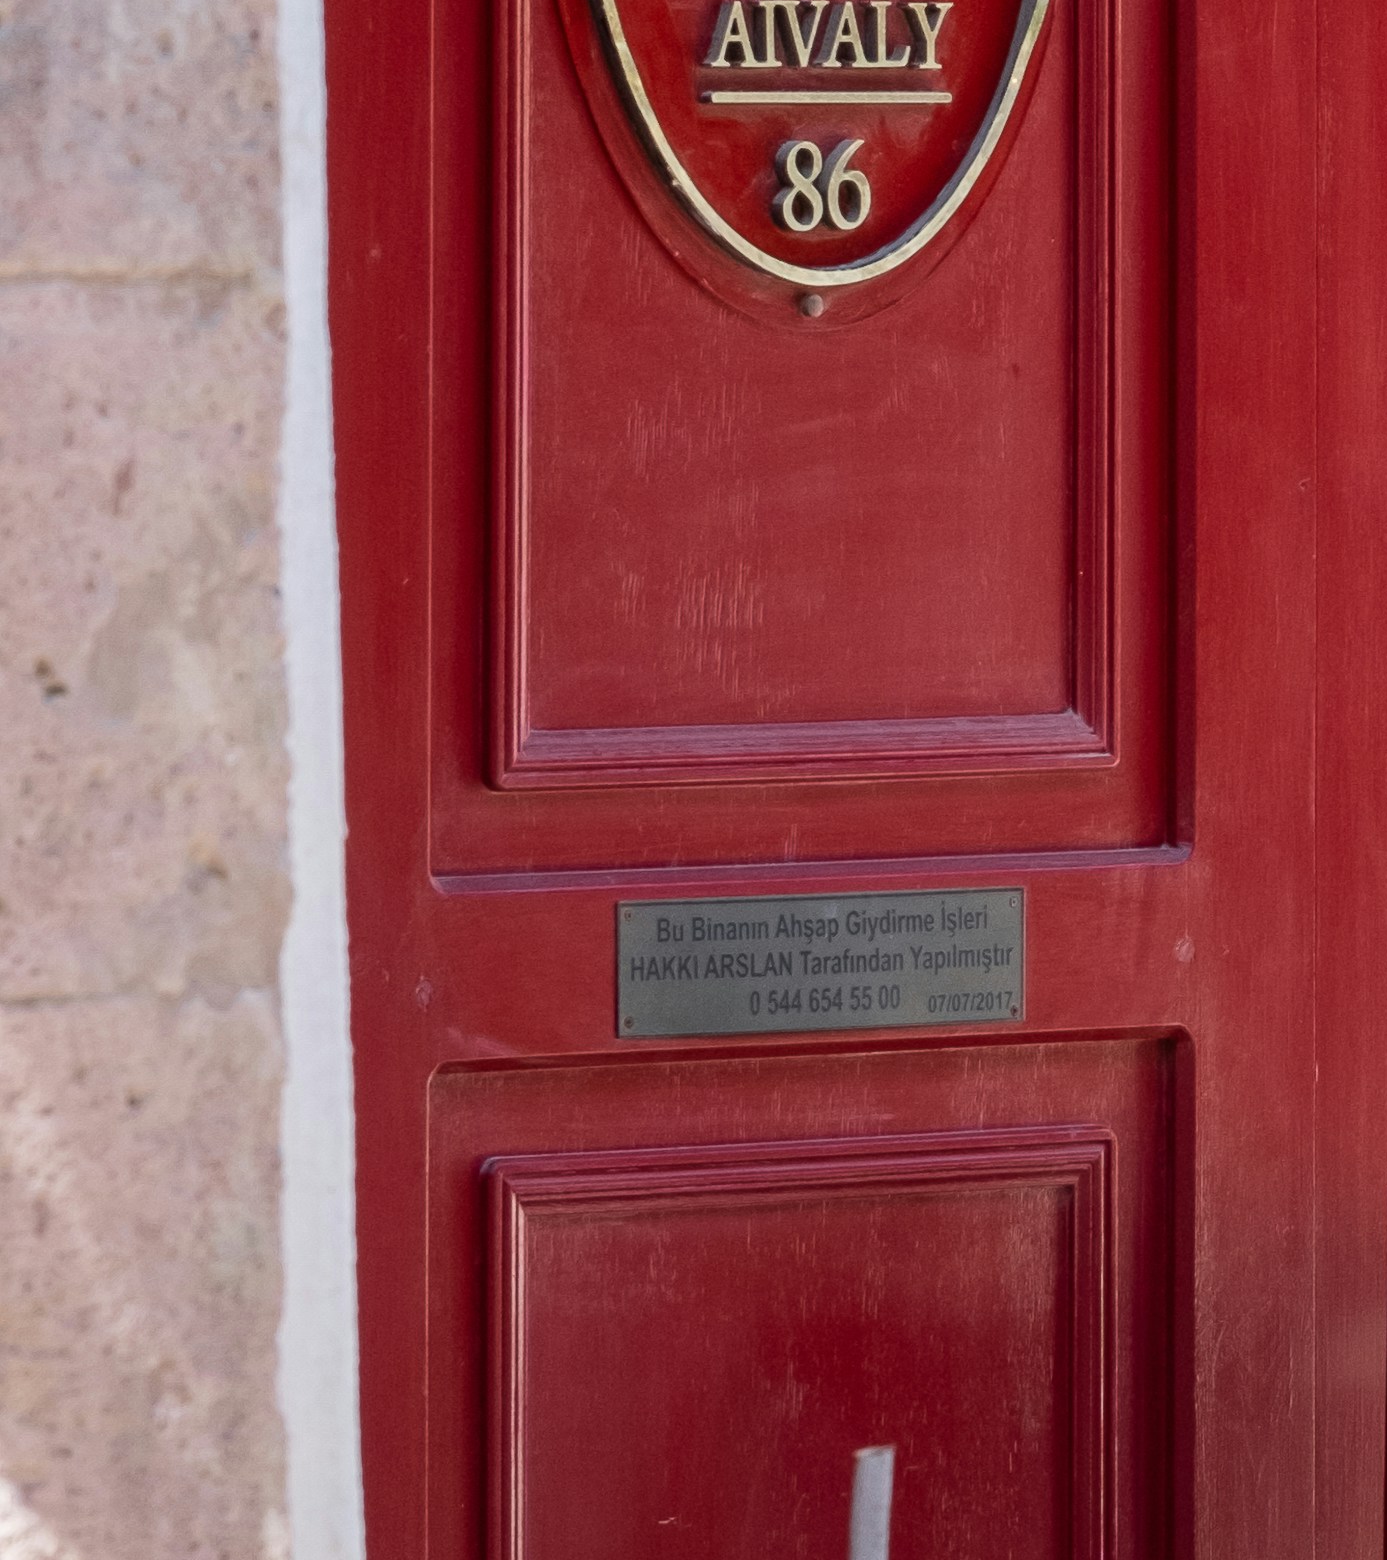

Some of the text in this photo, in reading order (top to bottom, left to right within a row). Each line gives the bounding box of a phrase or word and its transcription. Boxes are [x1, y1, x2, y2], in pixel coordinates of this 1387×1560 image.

[782, 138, 872, 232] 86
[657, 901, 988, 945] Bu Binanın Ahşap Giydirme İşleri
[630, 943, 1015, 981] HAKKI ARSLAN Tarafından Yapılmıştır
[750, 984, 901, 1016] 0 544 654 55 00
[927, 990, 1015, 1013] 07/07/2017
